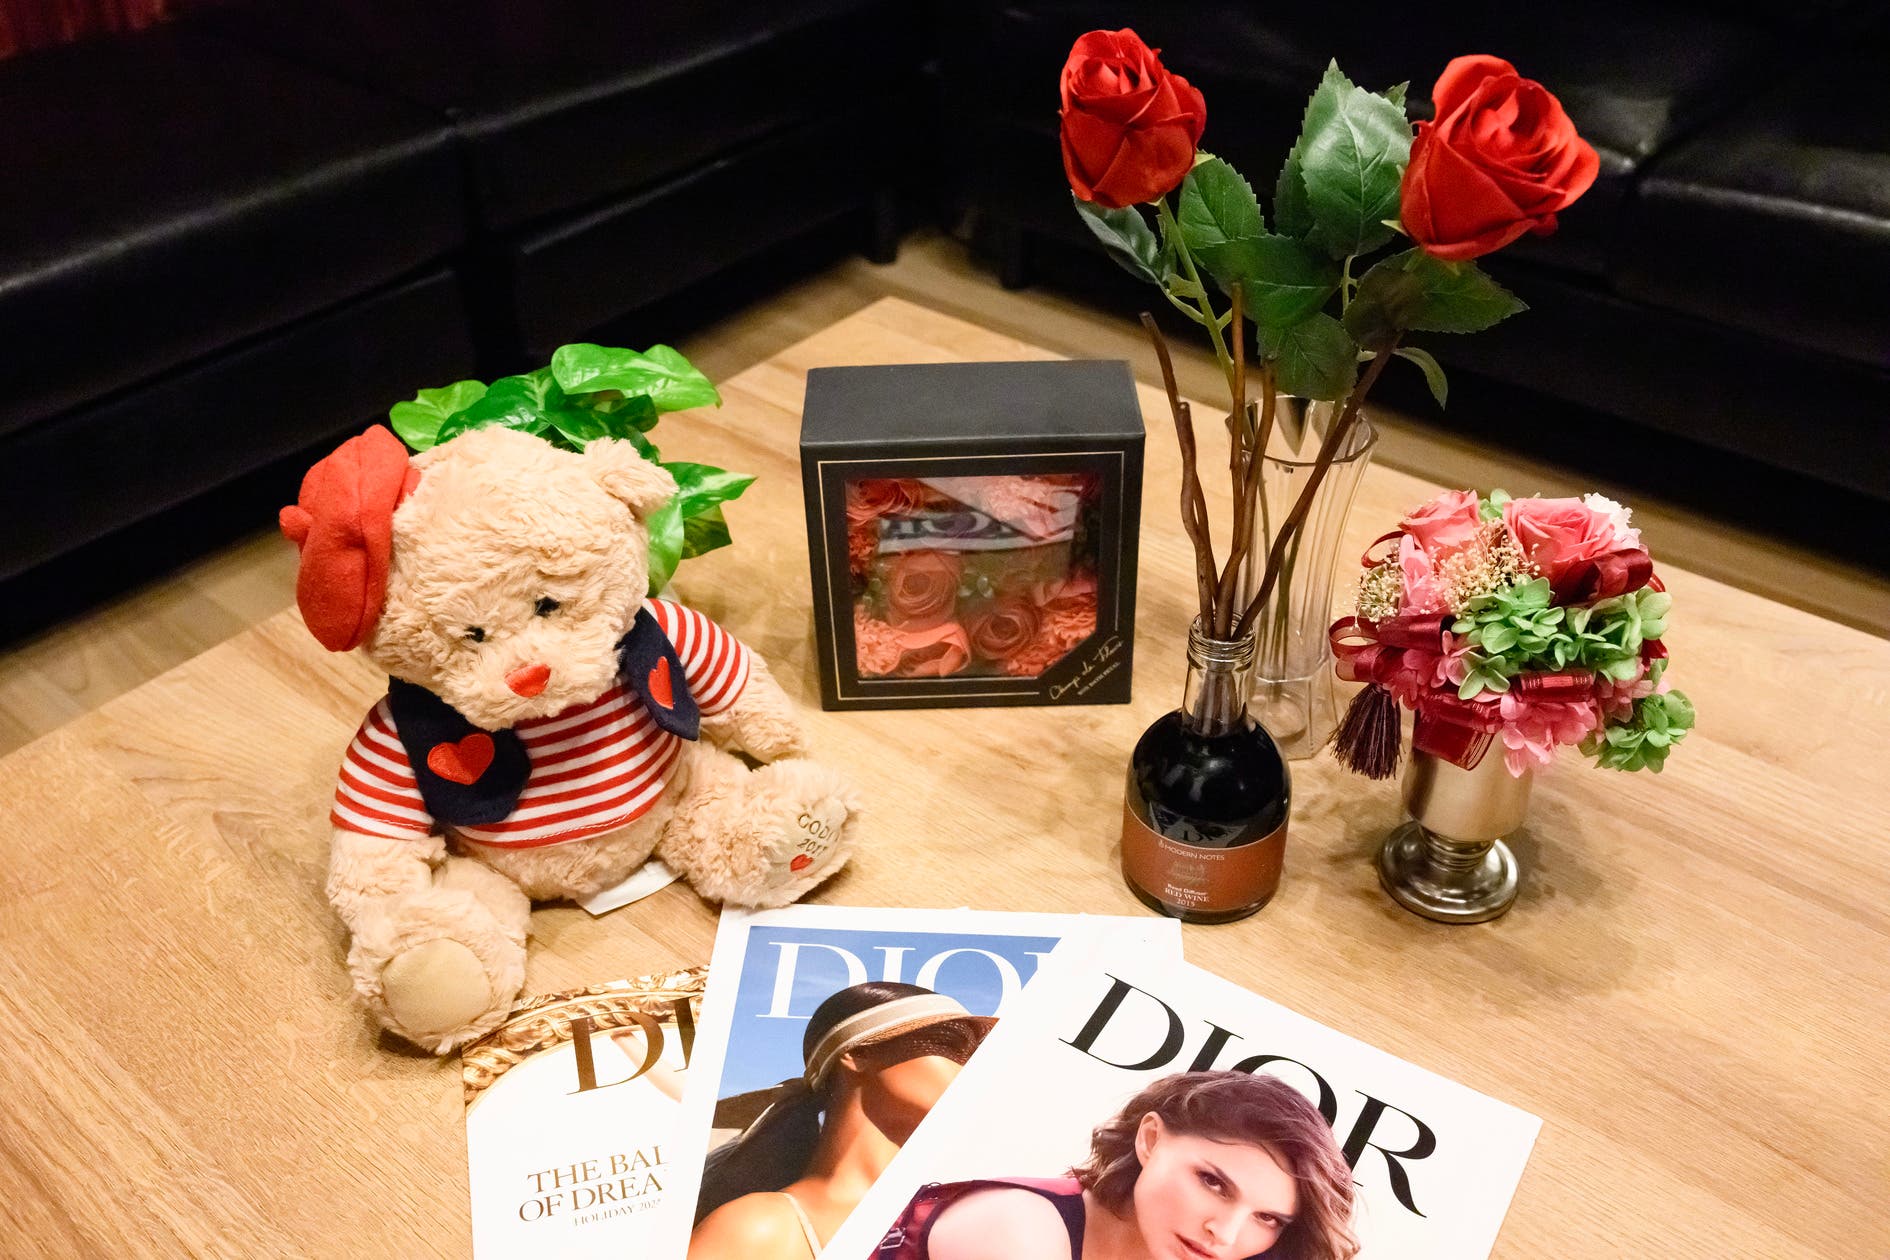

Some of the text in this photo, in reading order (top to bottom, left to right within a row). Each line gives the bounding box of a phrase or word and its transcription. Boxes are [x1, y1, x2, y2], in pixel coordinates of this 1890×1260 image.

[1164, 844, 1198, 859] MODERN
[1165, 887, 1210, 903] RED WINE
[755, 941, 1053, 1020] DIO
[527, 1159, 602, 1194] THE
[518, 1193, 564, 1222] OF
[573, 1204, 636, 1227] HOLIDAY
